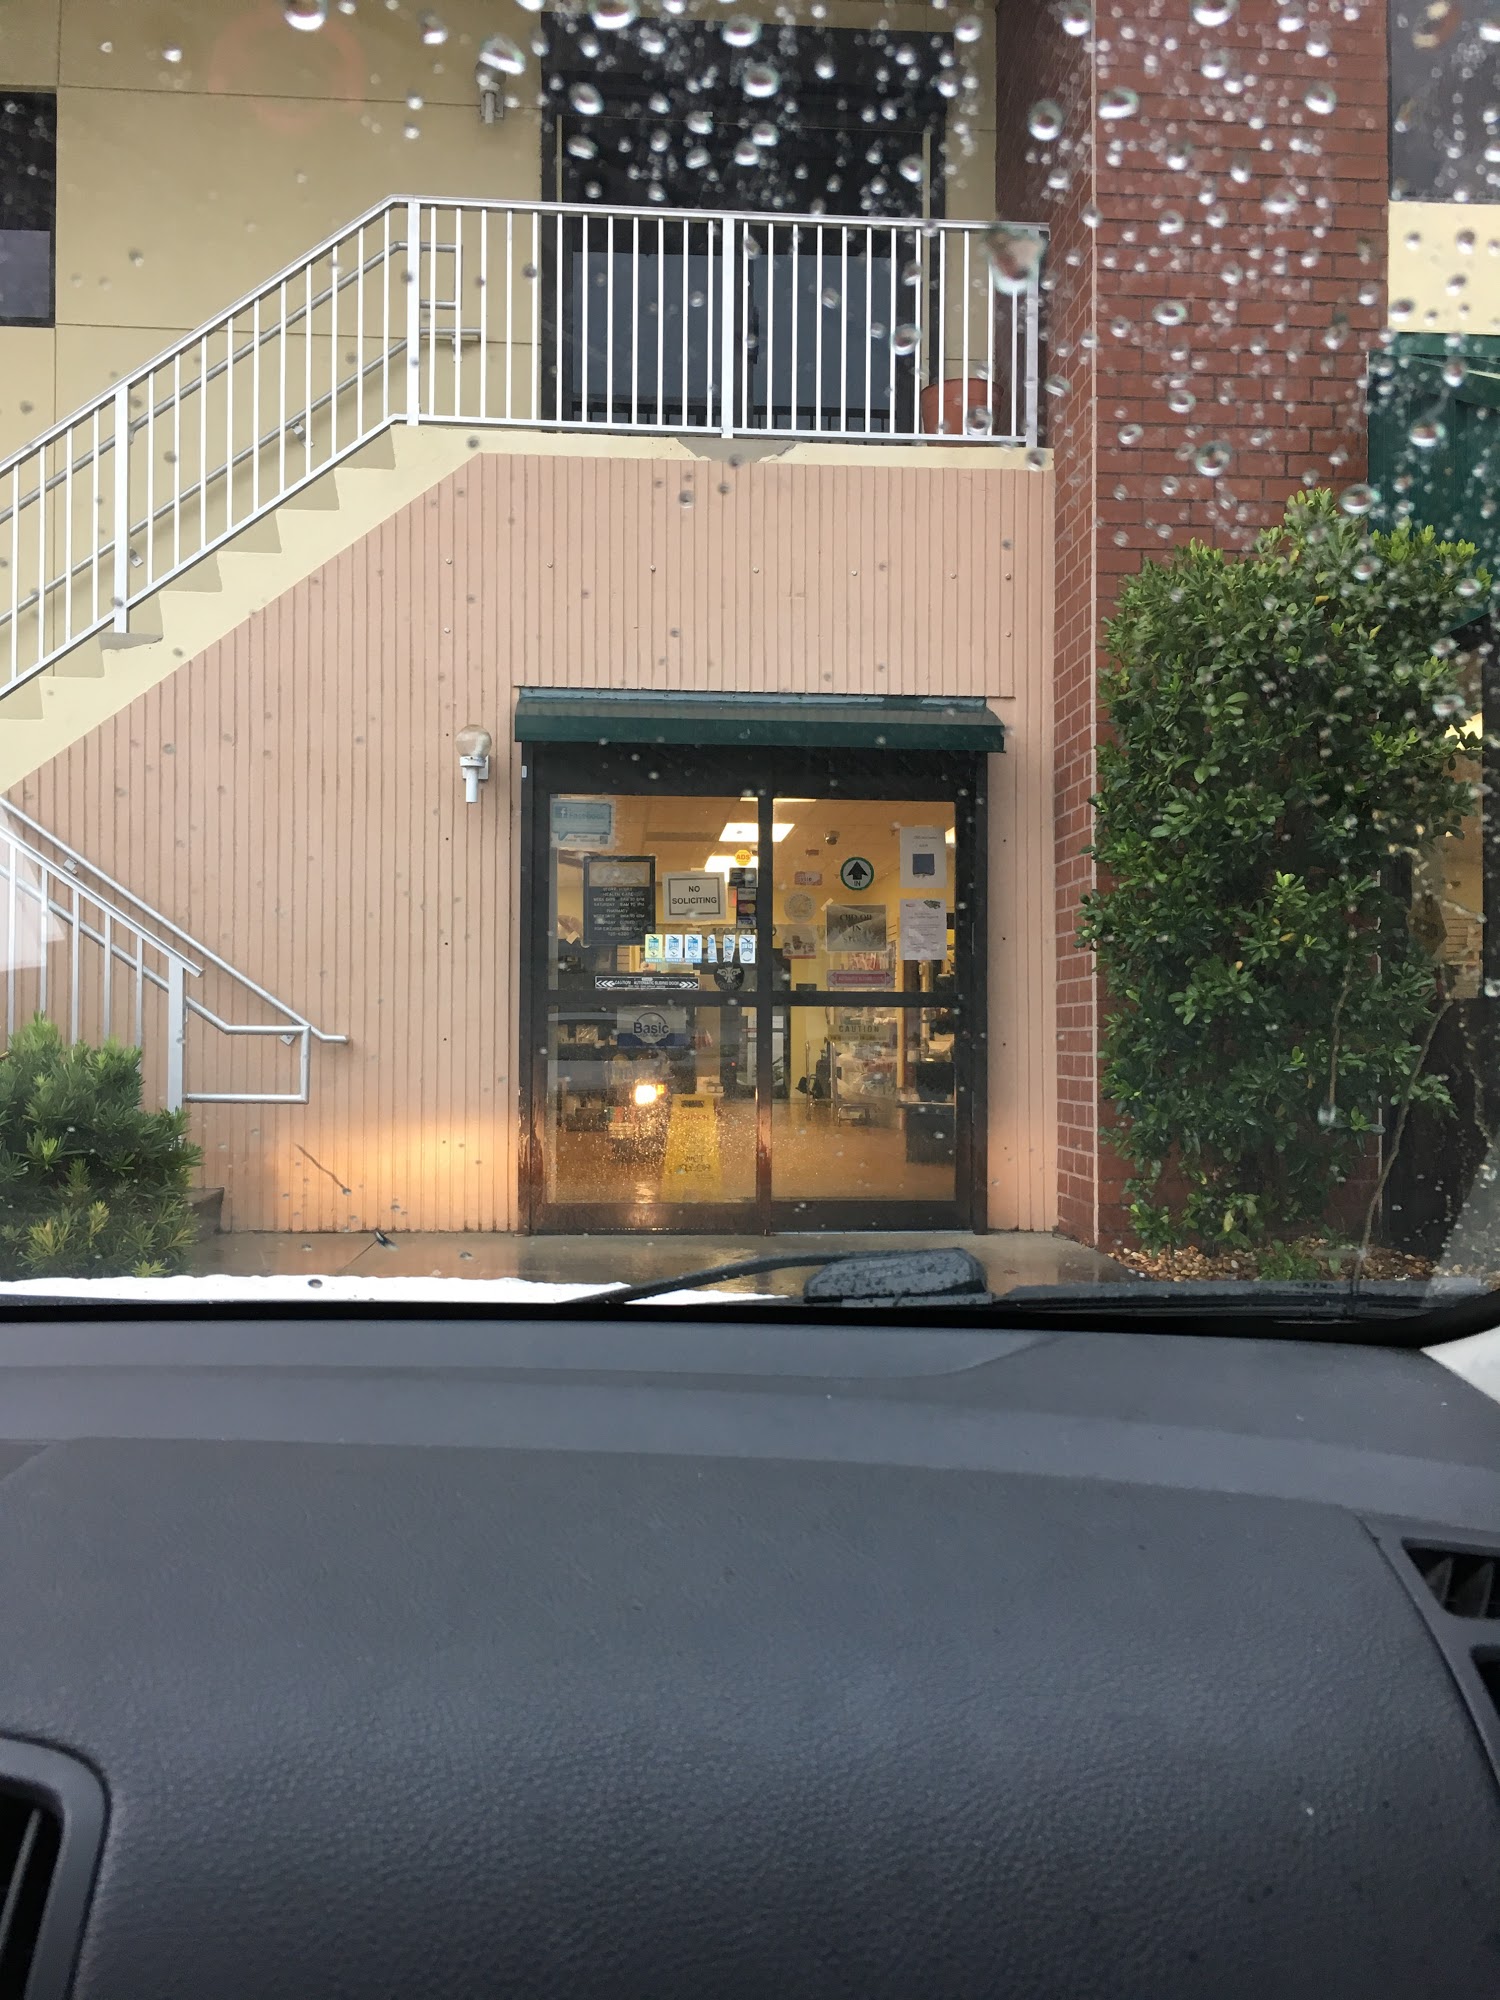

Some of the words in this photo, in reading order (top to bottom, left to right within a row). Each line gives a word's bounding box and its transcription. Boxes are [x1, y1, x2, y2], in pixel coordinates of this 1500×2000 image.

[688, 885, 701, 893] NO
[671, 896, 717, 905] SOLICITING
[633, 1021, 669, 1034] Basic
[838, 1025, 880, 1033] CAUTION
